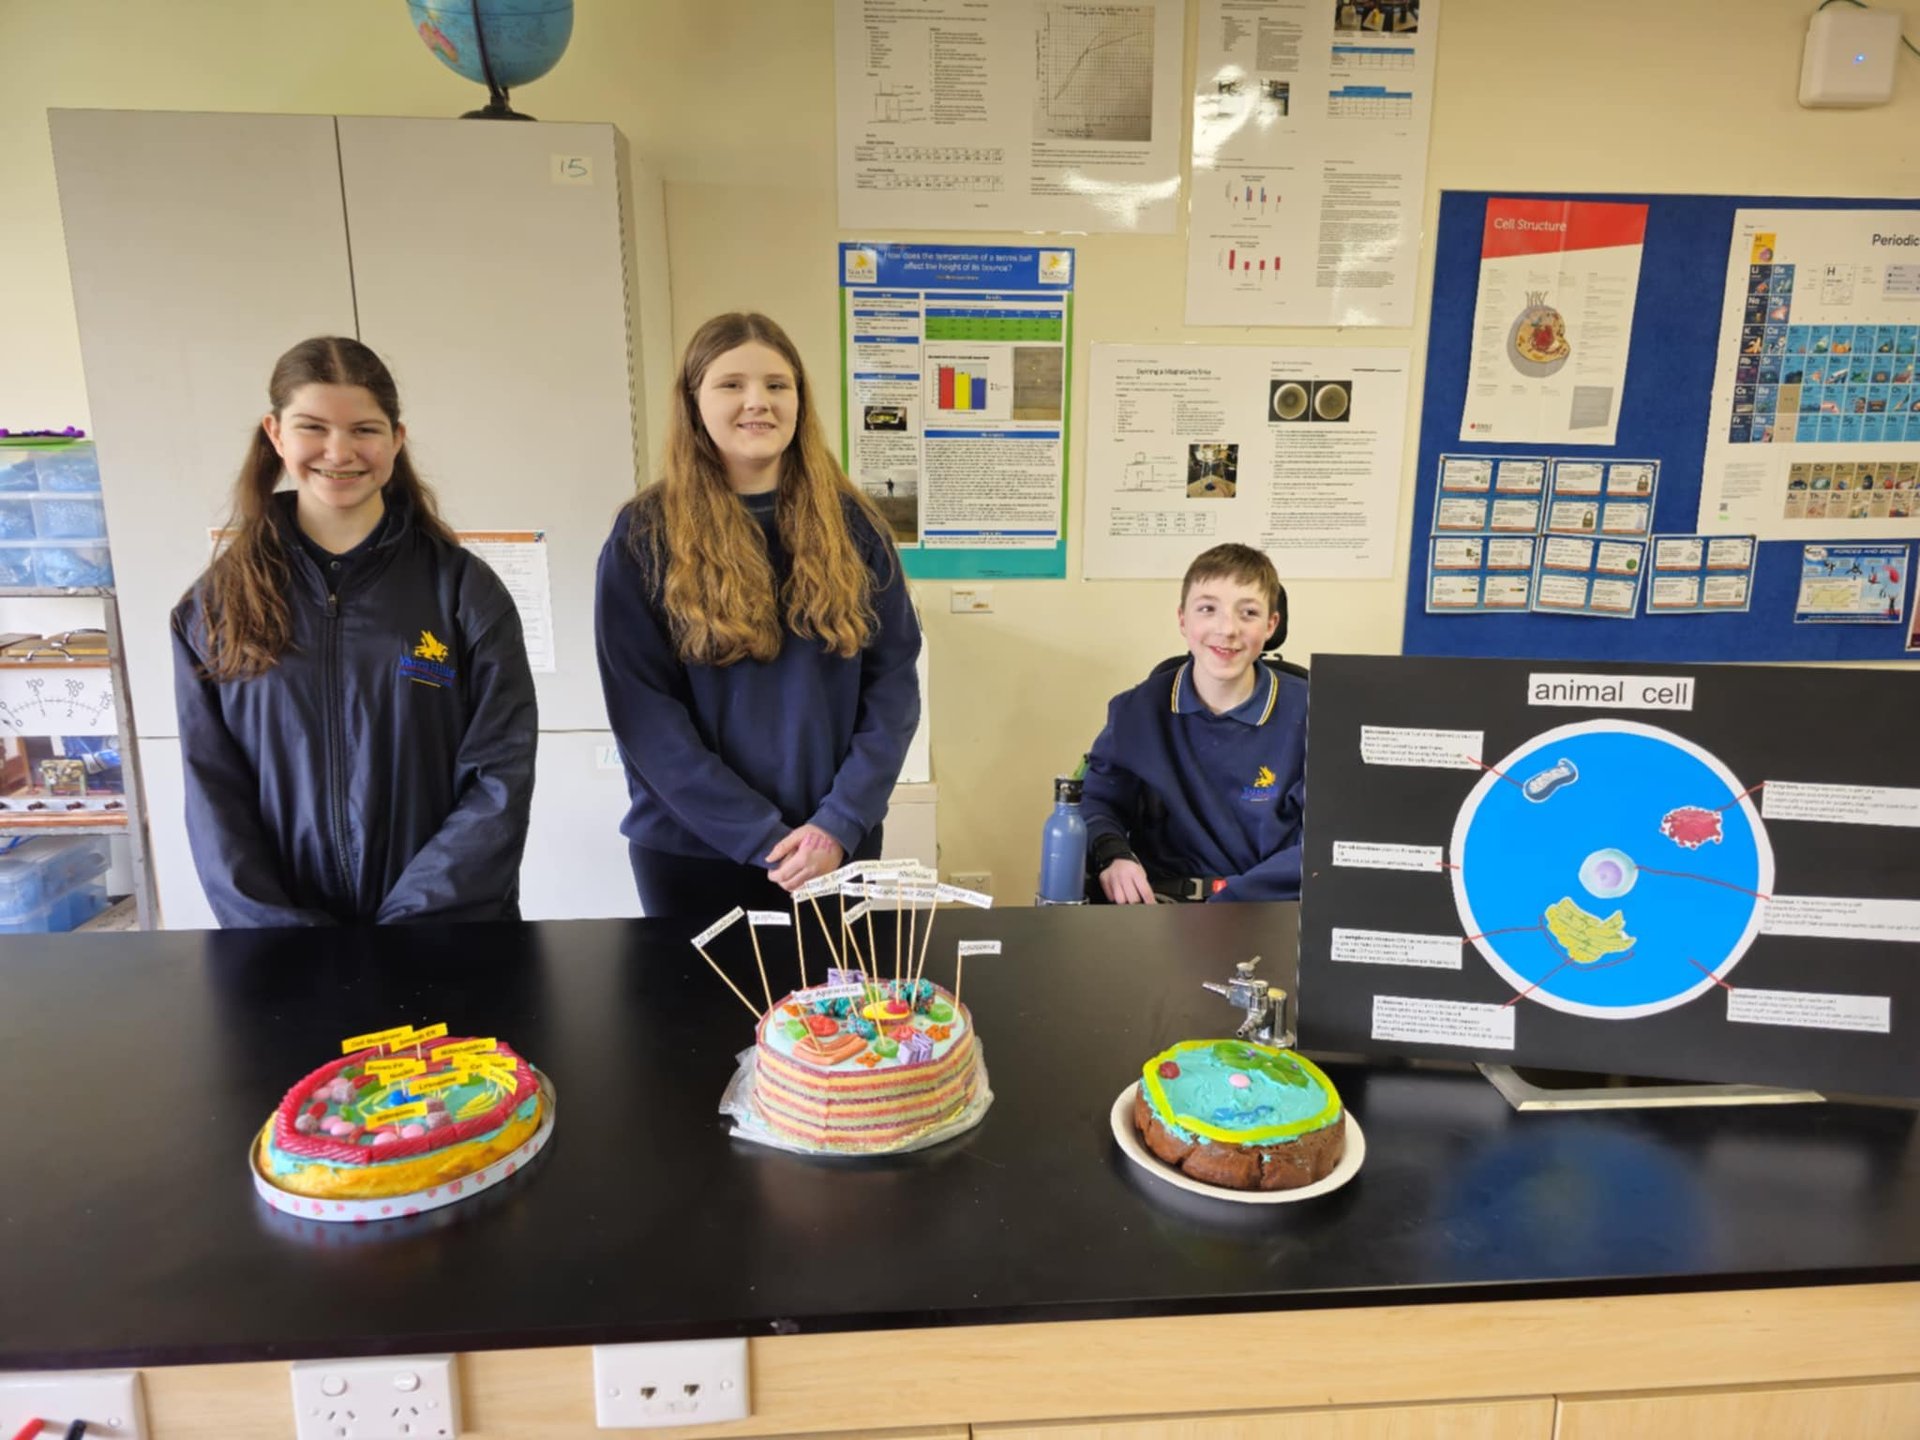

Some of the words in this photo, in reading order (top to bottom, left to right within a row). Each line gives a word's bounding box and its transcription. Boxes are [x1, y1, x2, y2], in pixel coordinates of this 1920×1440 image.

[560, 158, 588, 178] 15
[1494, 217, 1515, 230] Cell
[1517, 218, 1567, 232] Structure
[1872, 234, 1920, 247] Periodic
[903, 253, 920, 261] does
[922, 253, 934, 261] the
[935, 253, 978, 263] temperature
[1535, 679, 1624, 703] animal
[1642, 682, 1688, 705] cell
